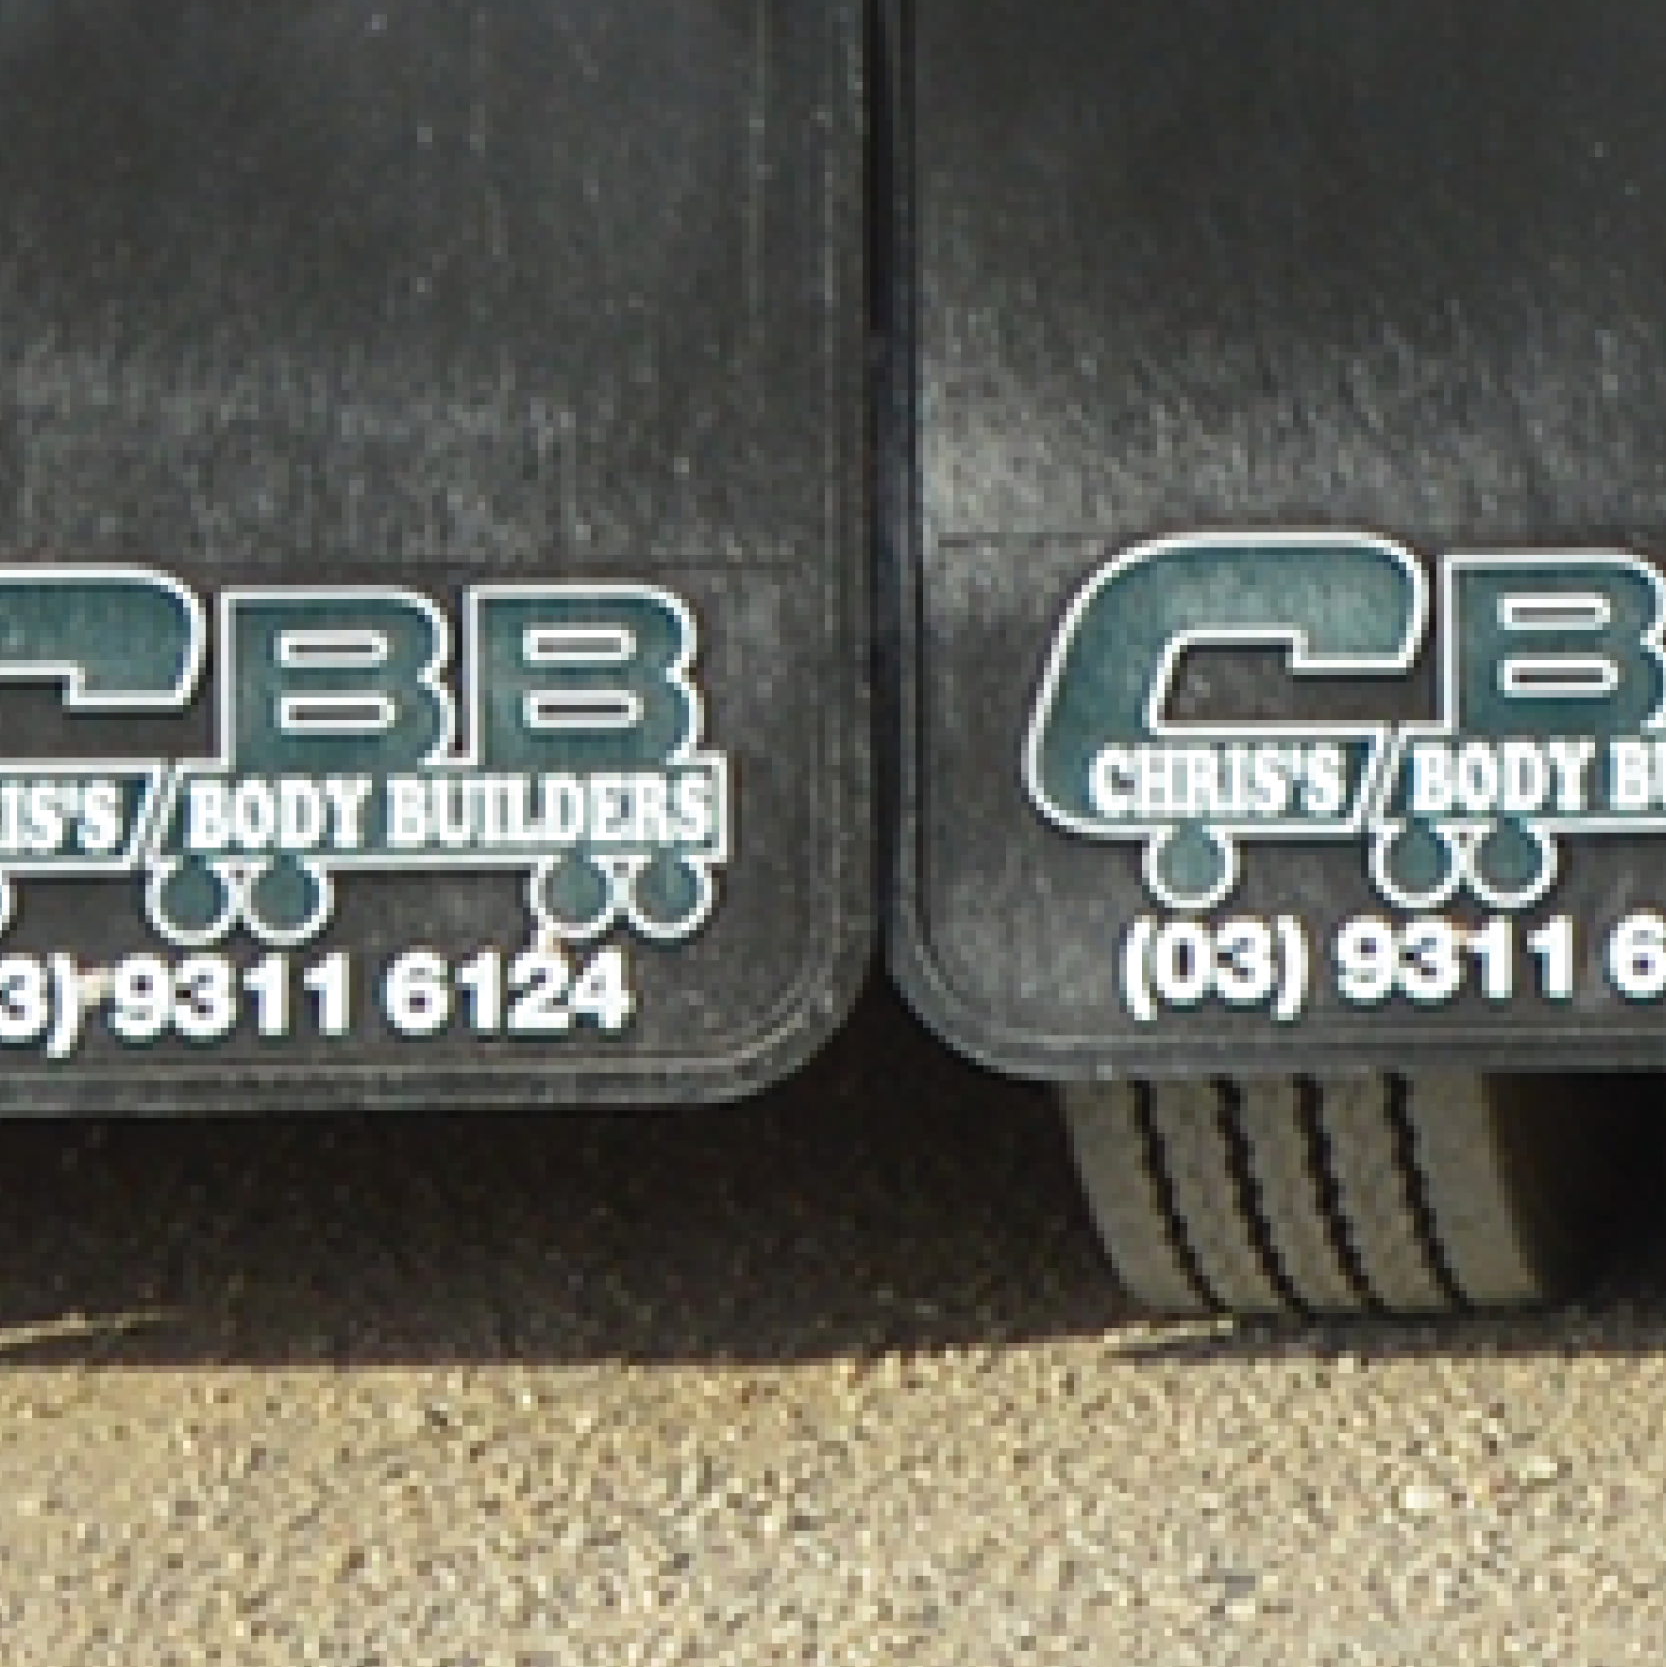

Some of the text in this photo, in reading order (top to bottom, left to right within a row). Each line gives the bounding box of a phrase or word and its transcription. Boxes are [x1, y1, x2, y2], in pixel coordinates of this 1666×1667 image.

[189, 775, 372, 849] BODY
[386, 772, 712, 842] BUILDERS
[1089, 742, 1345, 818] CHRIS'S
[1411, 741, 1596, 812] BODY
[108, 951, 350, 1036] 9311
[384, 947, 633, 1035] 6124
[1121, 915, 1309, 1021] (03)
[1332, 914, 1577, 1001] 9311
